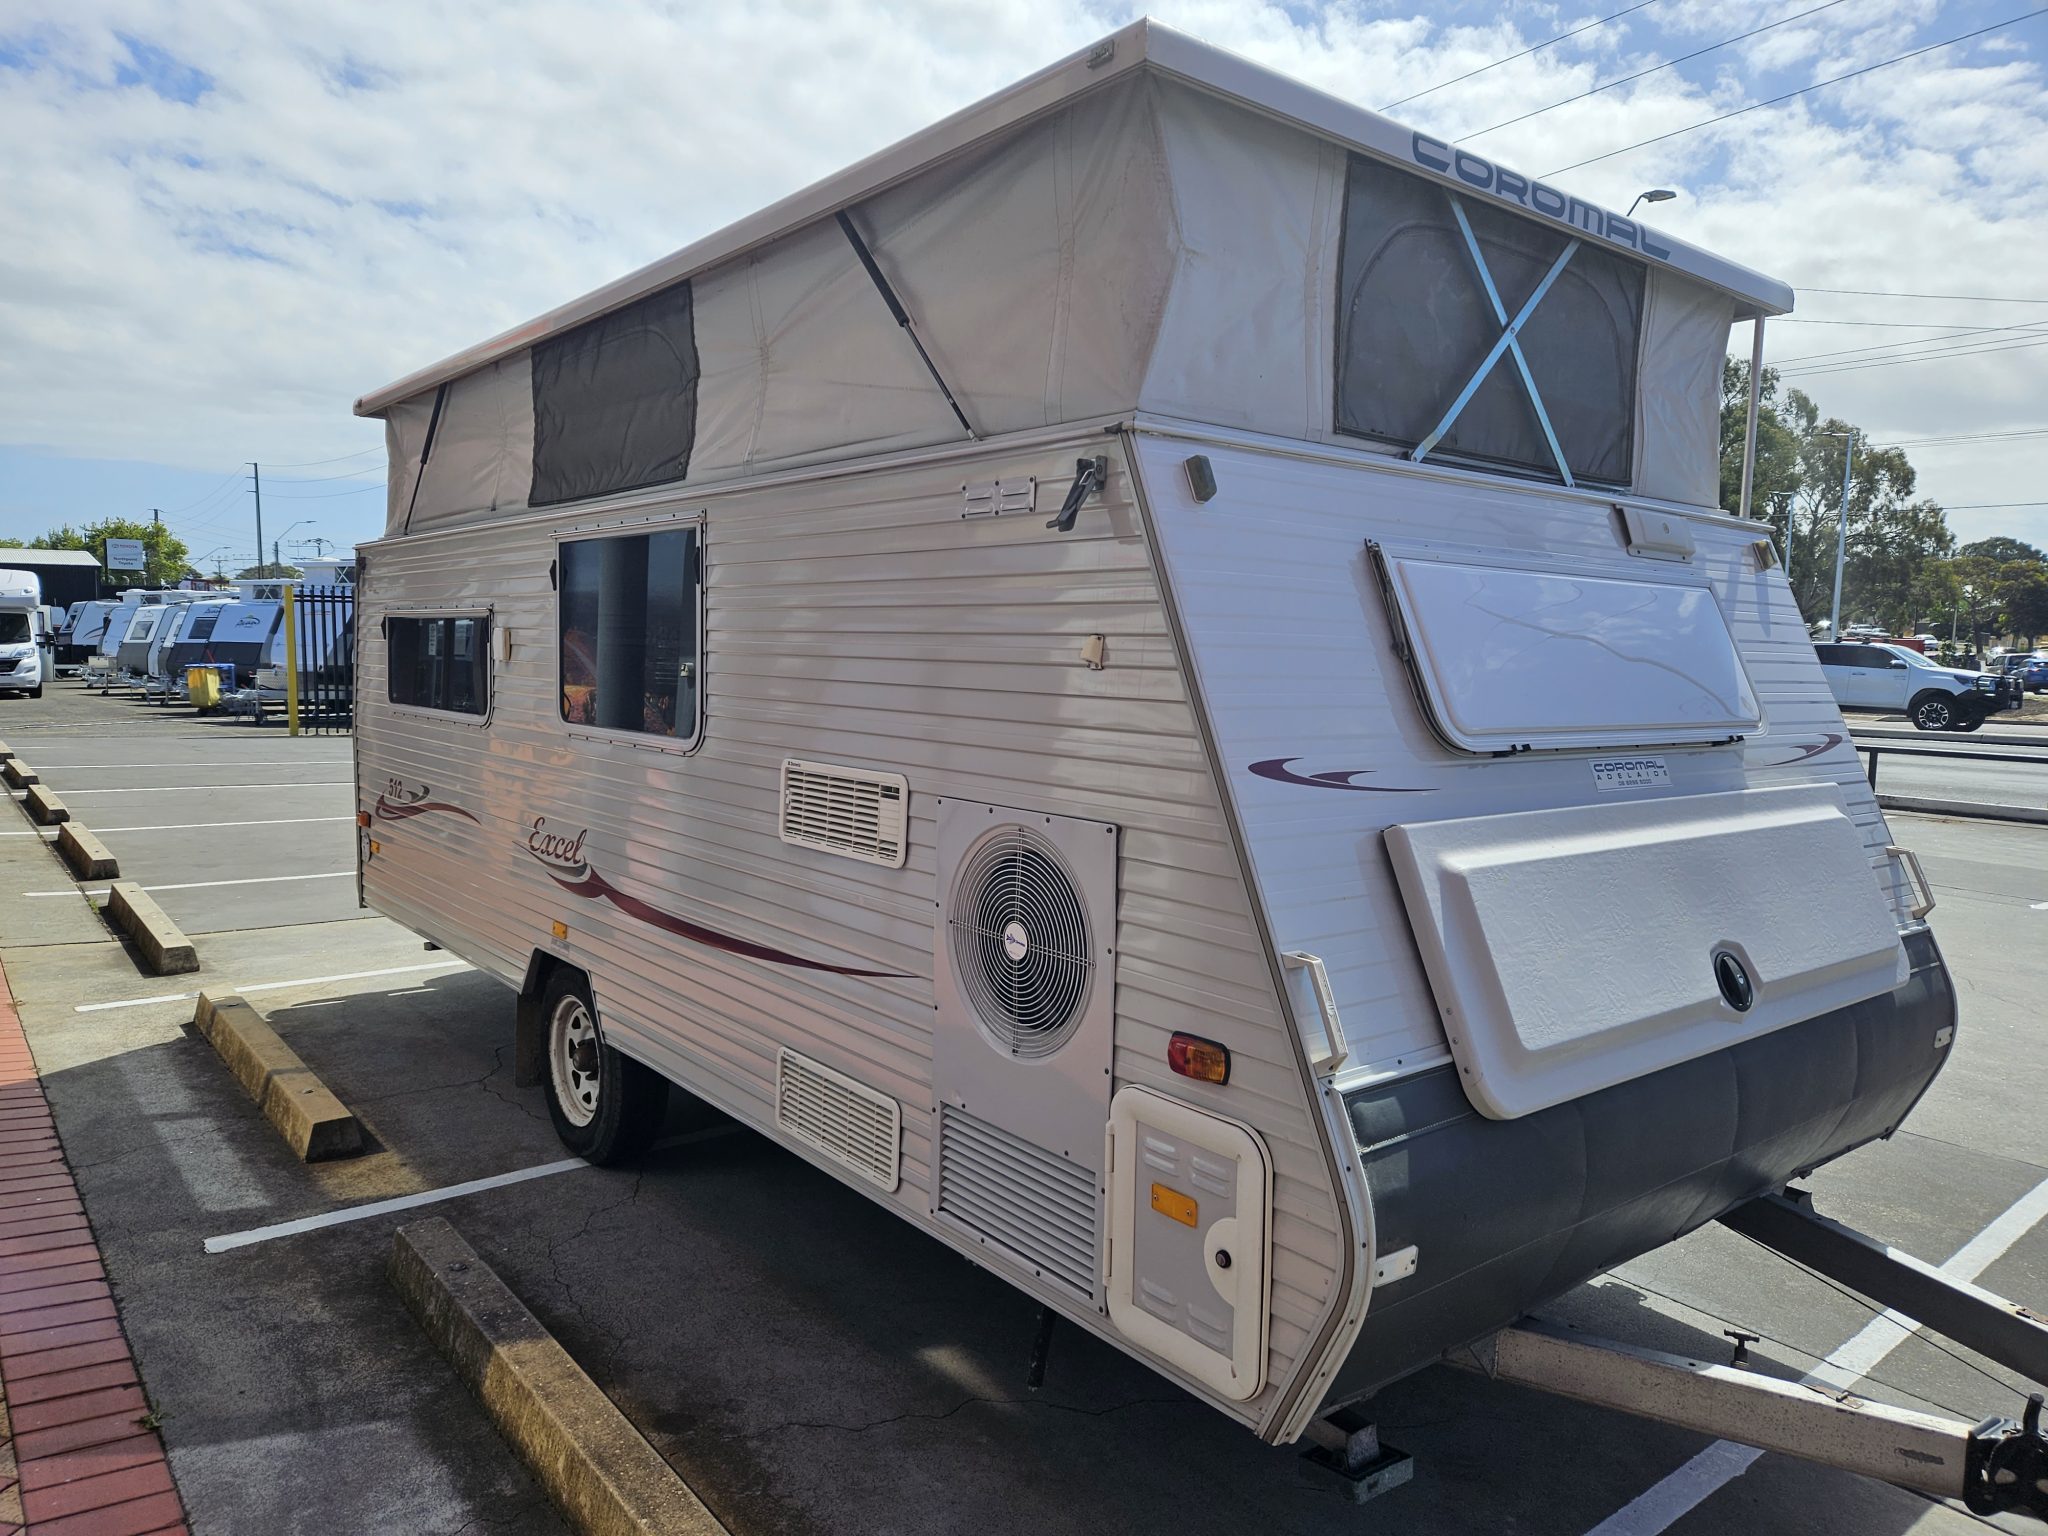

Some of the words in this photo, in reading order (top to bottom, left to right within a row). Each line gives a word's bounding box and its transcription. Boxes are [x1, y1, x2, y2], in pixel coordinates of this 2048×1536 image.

[1413, 130, 1671, 260] COROMAL
[1593, 761, 1664, 772] COROMAL
[1597, 770, 1668, 780] ADELAIDE
[389, 778, 402, 799] 512
[528, 816, 587, 864] Excel
